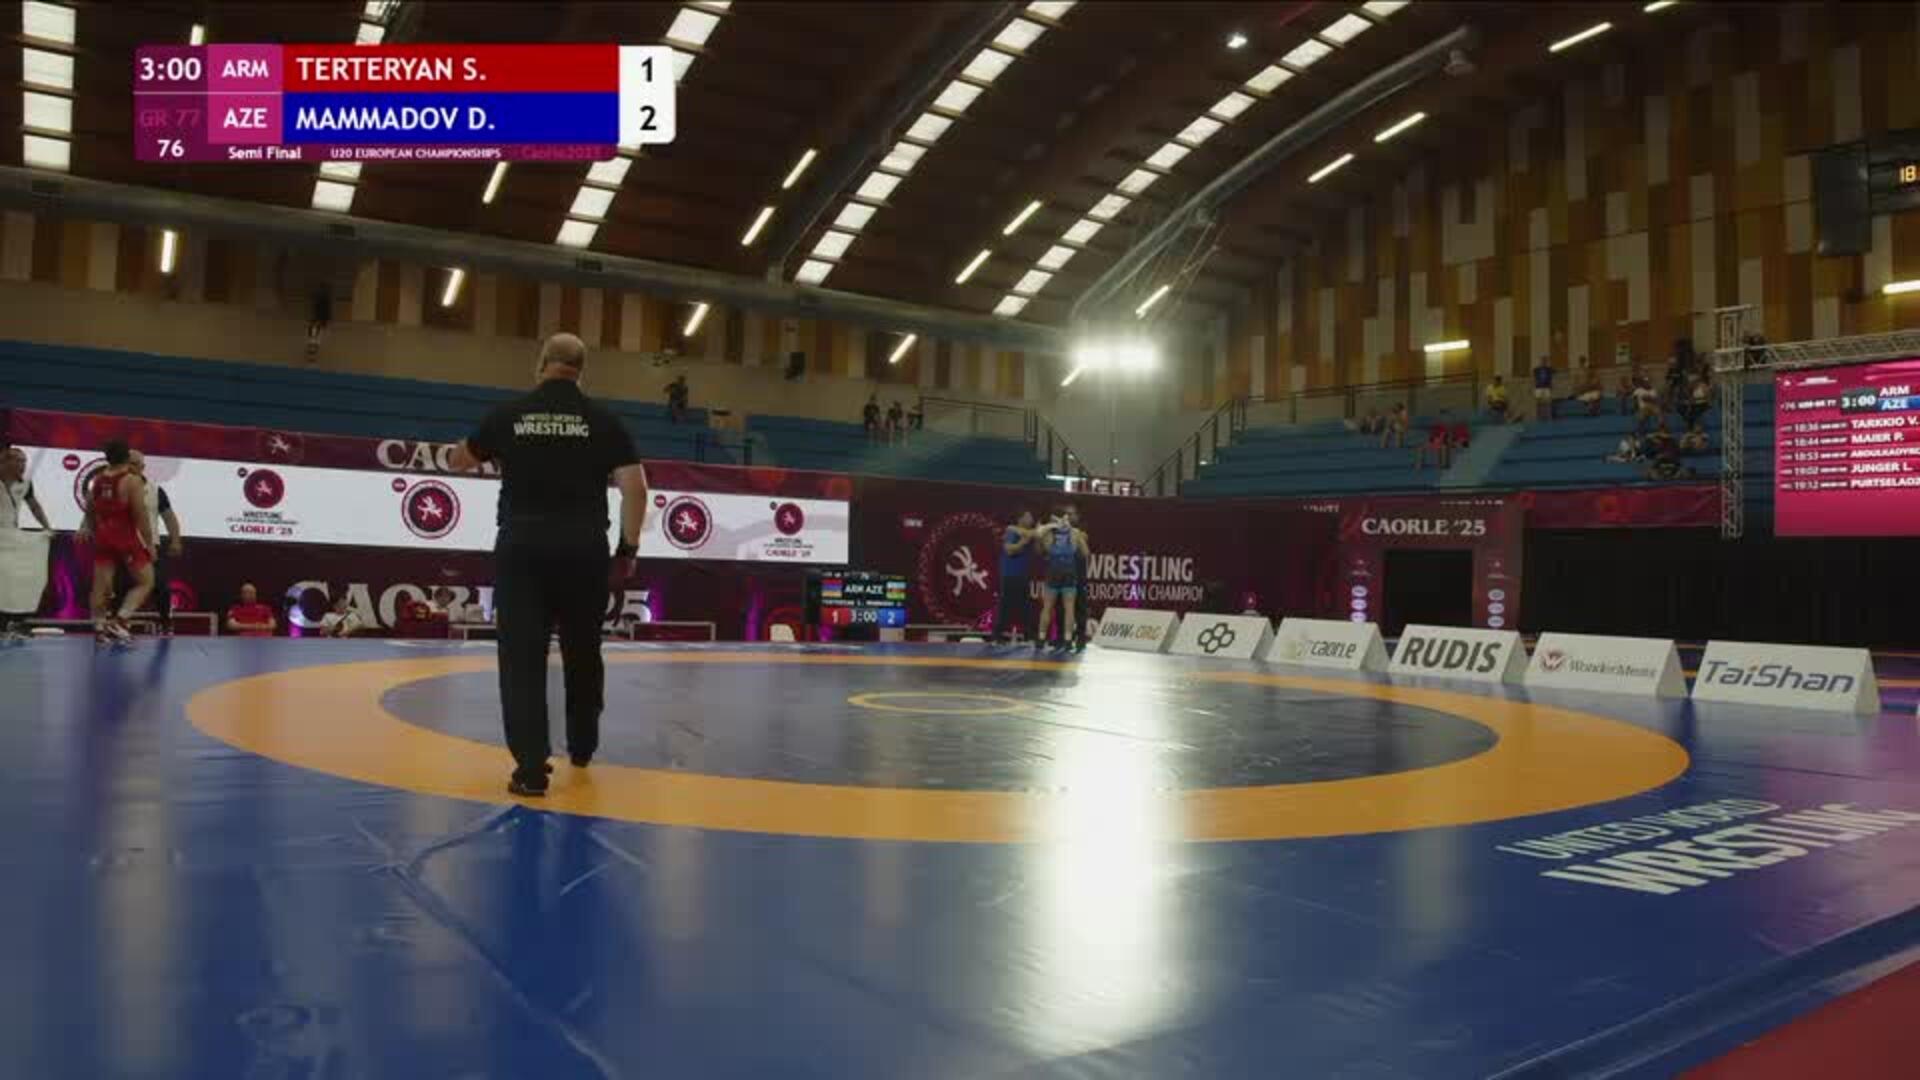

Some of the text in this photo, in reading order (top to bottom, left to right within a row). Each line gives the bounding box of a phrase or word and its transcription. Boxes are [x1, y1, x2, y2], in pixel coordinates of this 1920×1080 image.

[1879, 385, 1910, 396] ARM
[1841, 395, 1877, 408] 3:00
[1881, 399, 1908, 410] AZE
[513, 421, 590, 437] WRESTLING
[1851, 433, 1891, 443] MAIER
[1850, 462, 1900, 473] JUNGER
[1360, 518, 1488, 538] CAORLE '25
[1087, 553, 1194, 582] WRESTLING
[1398, 636, 1503, 674] RUDIS
[1703, 659, 1855, 694] TaiShan
[1495, 818, 1672, 860] UNITED
